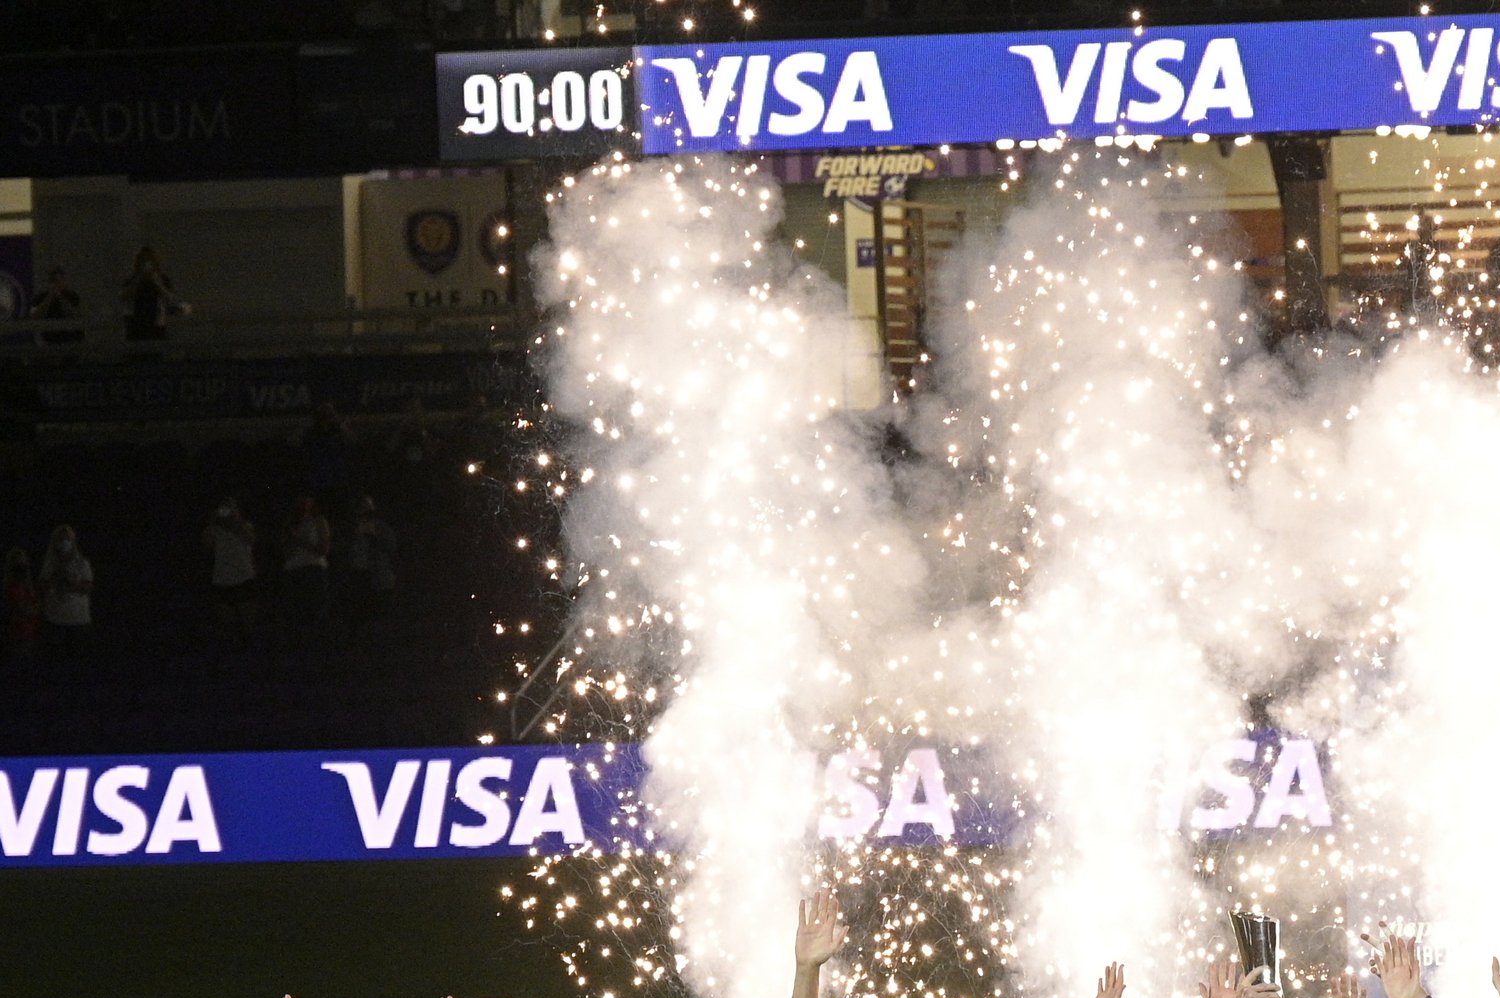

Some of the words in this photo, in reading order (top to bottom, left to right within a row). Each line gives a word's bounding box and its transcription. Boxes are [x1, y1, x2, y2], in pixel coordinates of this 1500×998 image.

[461, 69, 624, 135] 90:00
[652, 50, 893, 137] VISA
[1009, 37, 1254, 125] VISA
[19, 99, 231, 145] STADIUM
[815, 152, 925, 178] FORWARD
[823, 176, 881, 198] FARE
[405, 289, 461, 308] THE
[0, 763, 223, 857] VISA
[321, 756, 586, 849] VISA
[810, 747, 957, 839] SA
